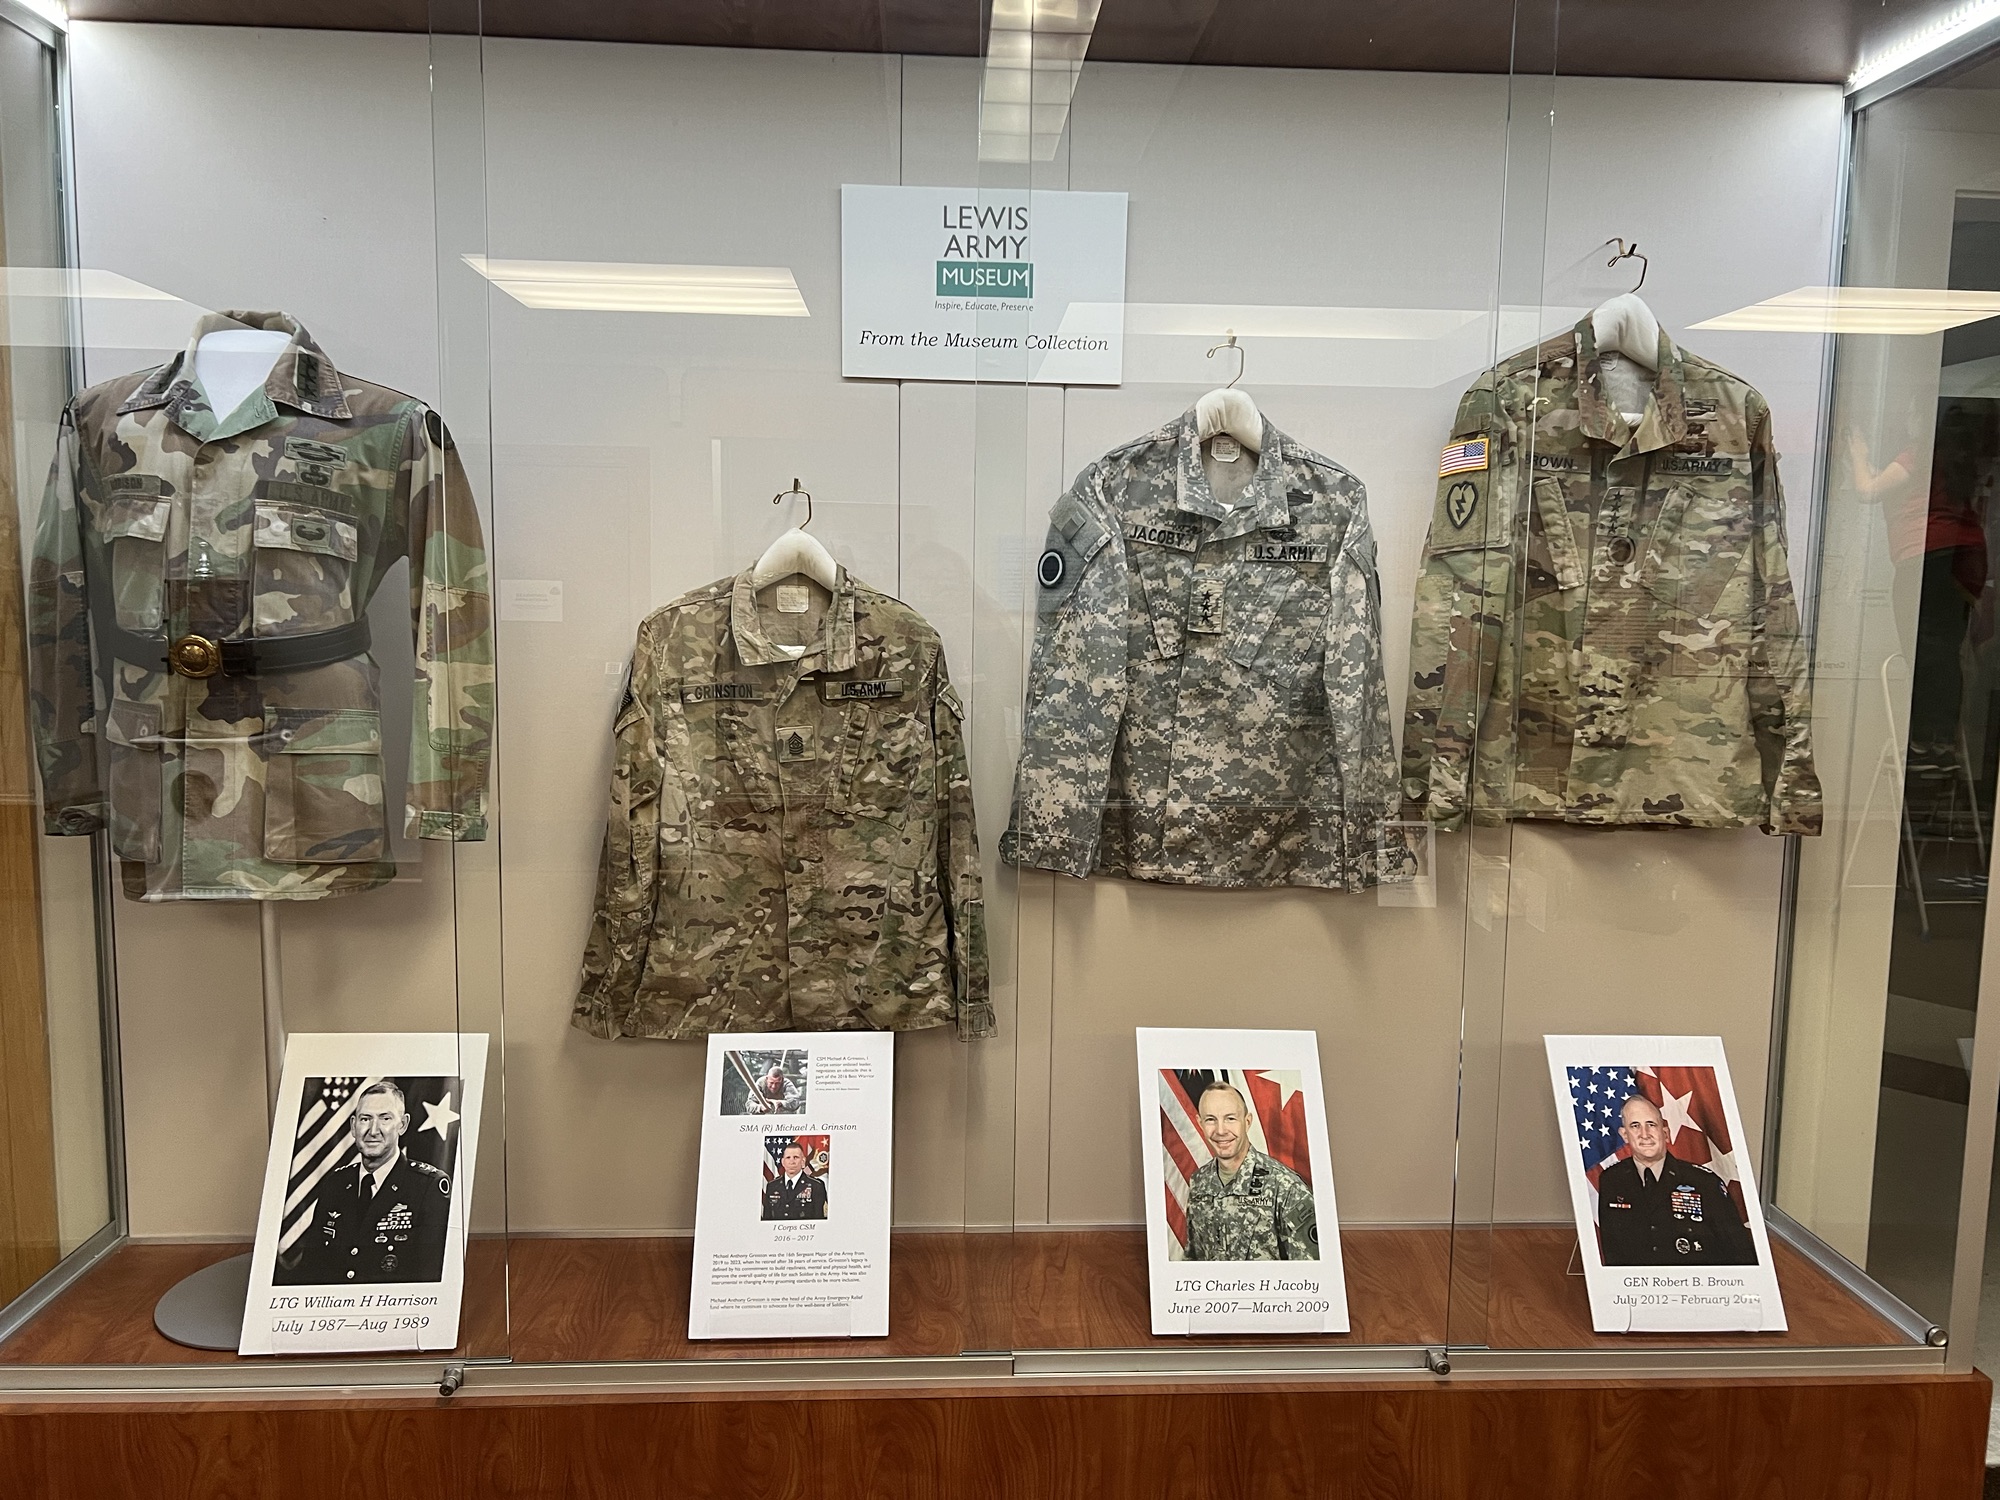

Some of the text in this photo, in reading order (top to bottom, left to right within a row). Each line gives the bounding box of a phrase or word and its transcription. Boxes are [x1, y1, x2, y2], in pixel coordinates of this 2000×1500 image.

[943, 205, 1028, 230] LEWIS
[944, 235, 1027, 259] ARMY
[942, 267, 1028, 287] MUSEUM
[934, 301, 963, 311] Inspire,
[965, 302, 999, 311] Educate,
[859, 331, 1108, 351] From the Museum Collection
[1129, 525, 1185, 547] JACOBY
[694, 684, 753, 700] GRINSTON
[761, 1124, 773, 1133] (R)
[821, 1123, 857, 1131] Grinston
[1175, 1279, 1319, 1294] LTG Charles H Jacoby
[1623, 1277, 1744, 1287] GEN Robert B. Brown
[269, 1294, 438, 1309] LTG William H Harrison
[1168, 1302, 1200, 1313] June
[1296, 1301, 1330, 1313] 2009
[1613, 1295, 1637, 1307] July
[1641, 1295, 1668, 1305] 2012
[1681, 1295, 1730, 1306] February
[272, 1320, 303, 1335] July
[392, 1316, 430, 1329] 1989
